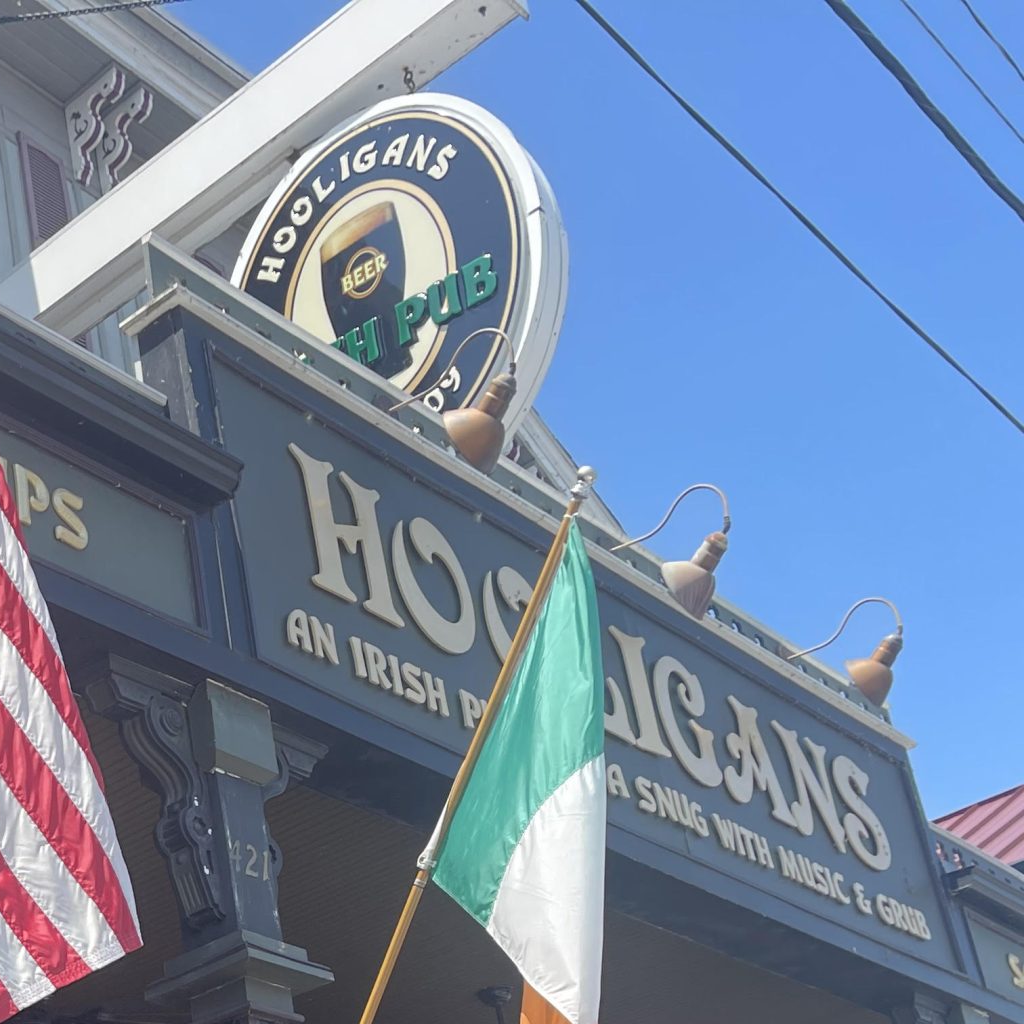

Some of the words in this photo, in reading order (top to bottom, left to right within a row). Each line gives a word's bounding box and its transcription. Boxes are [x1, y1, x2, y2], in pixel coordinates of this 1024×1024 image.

[257, 133, 458, 284] HOOLIGANS
[340, 252, 389, 295] BEER
[394, 252, 498, 346] PUB
[286, 608, 340, 665] AN
[349, 636, 450, 717] IRISH
[229, 840, 271, 881] 421
[607, 763, 632, 799] A
[634, 775, 710, 838] SNUG
[711, 812, 775, 870] WITH
[778, 845, 851, 905] MUSIC
[852, 881, 874, 916] &
[876, 893, 933, 942] GRUB
